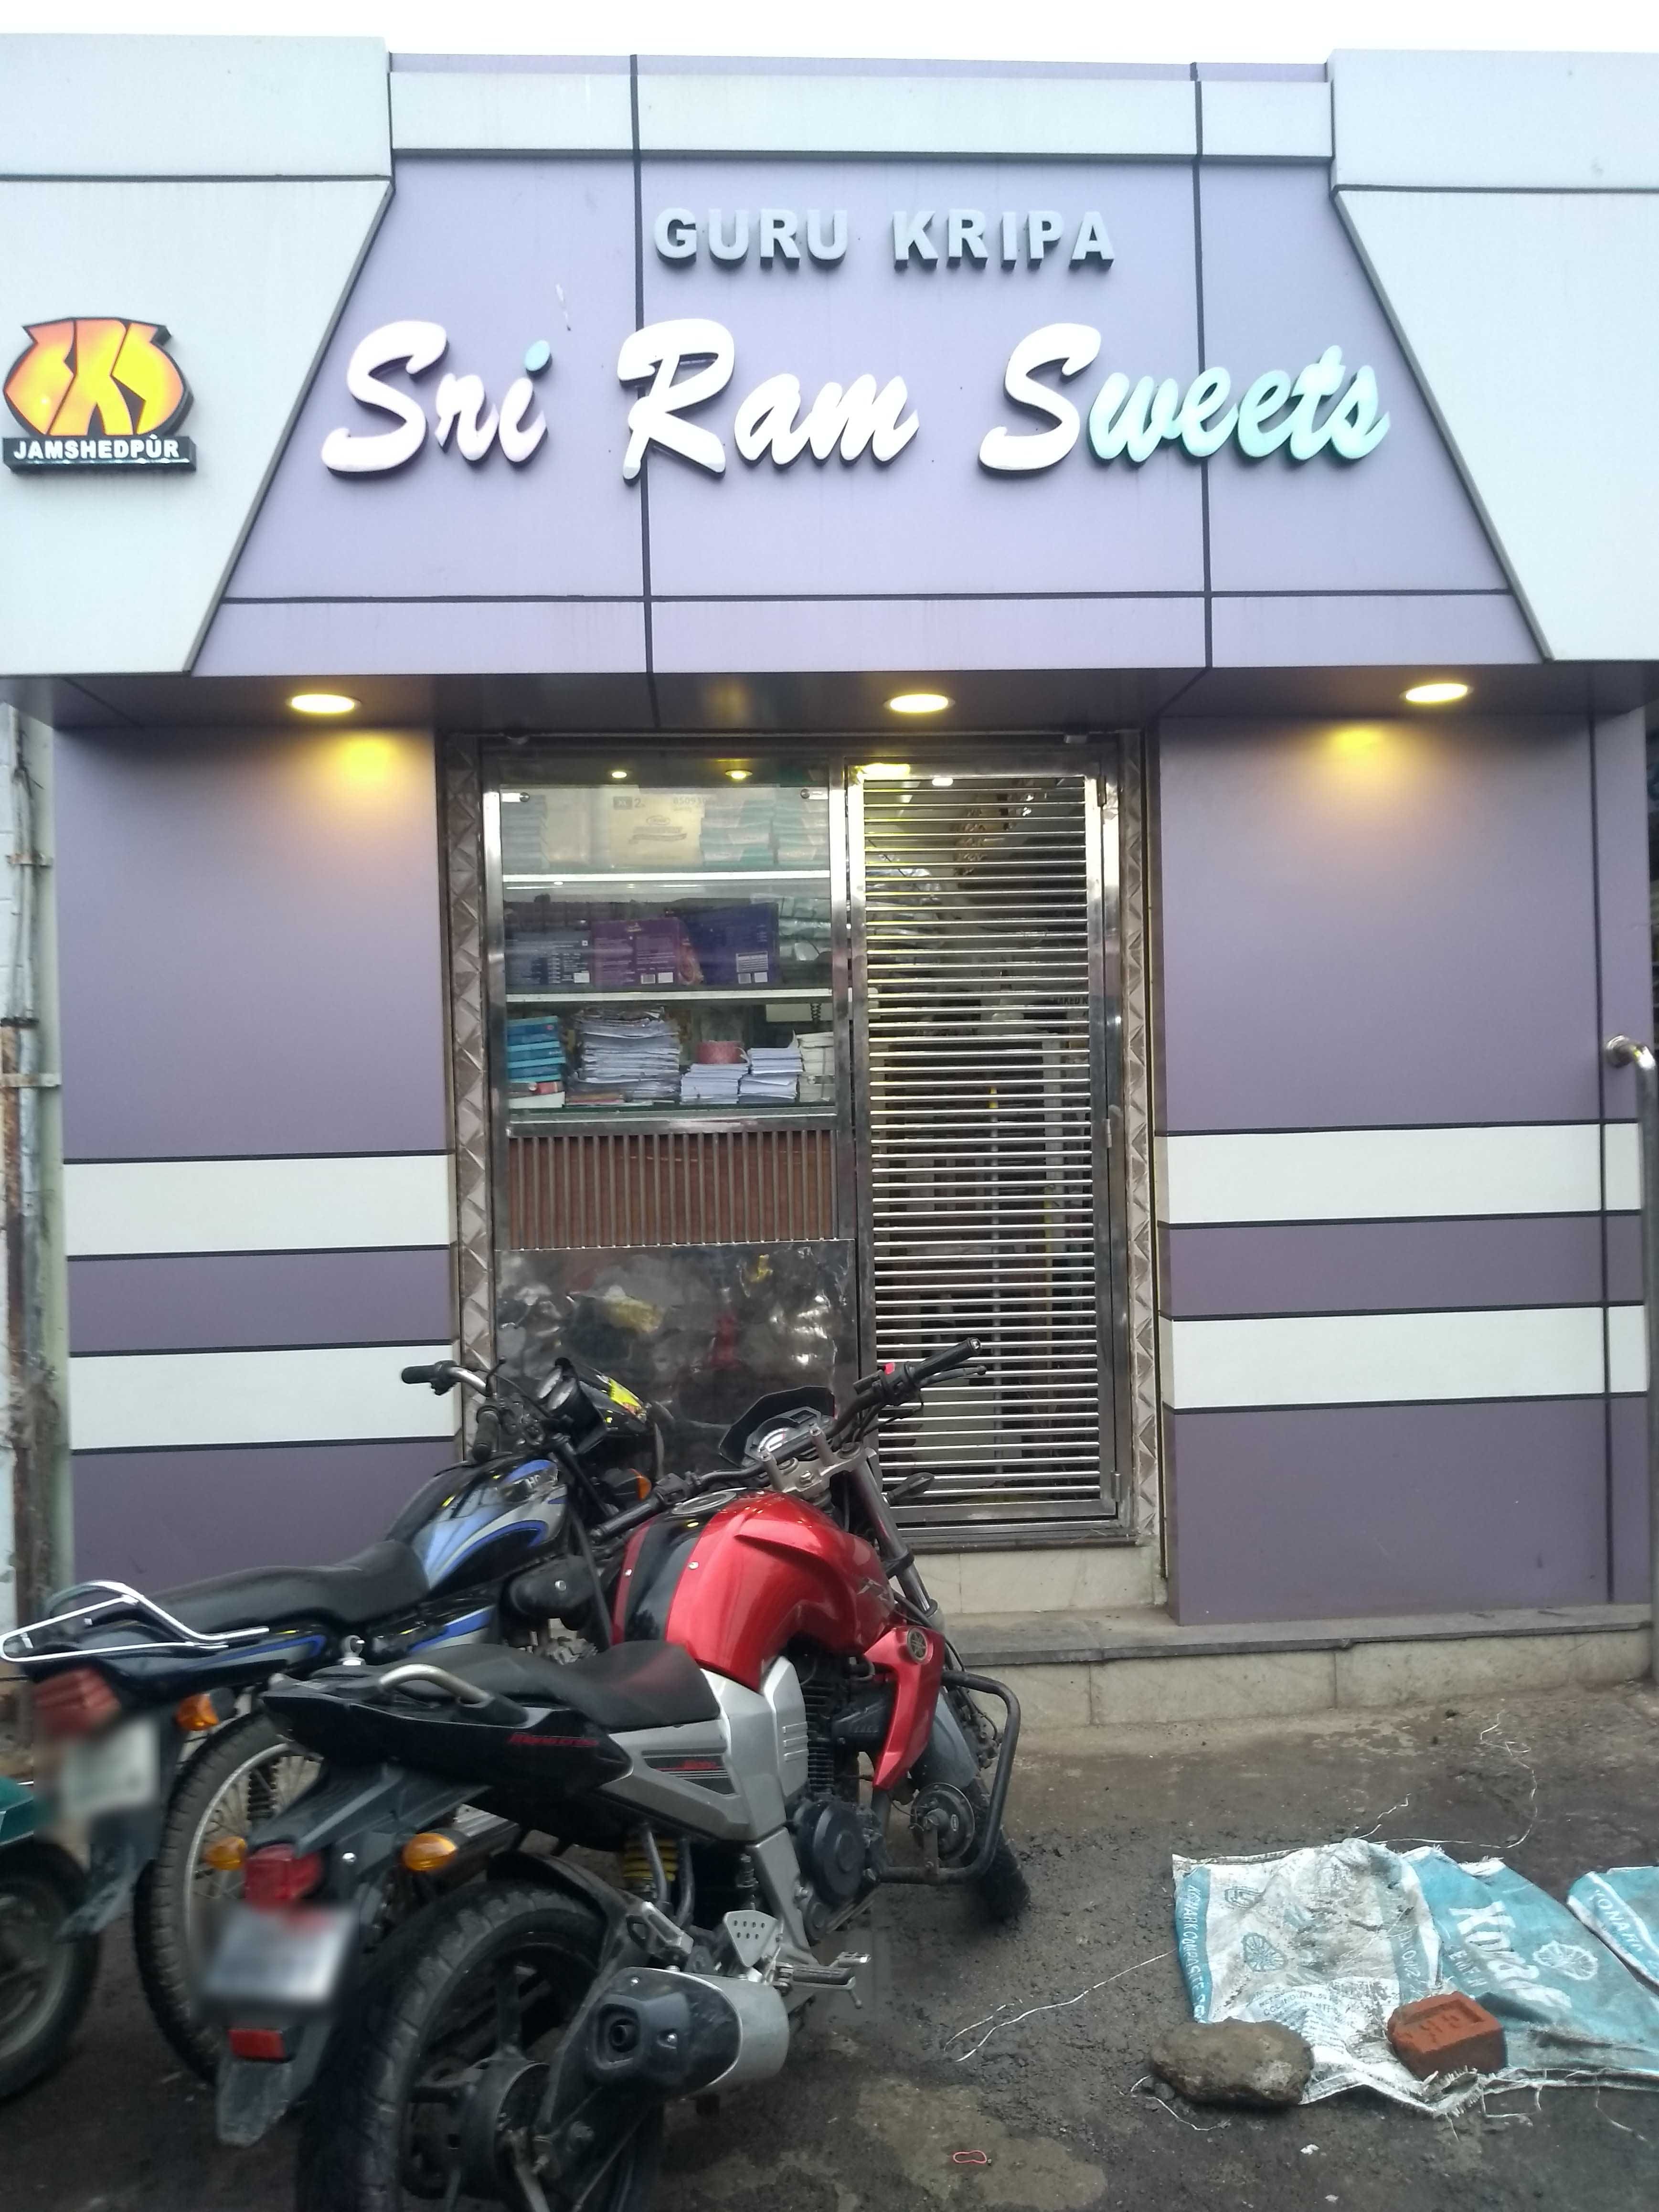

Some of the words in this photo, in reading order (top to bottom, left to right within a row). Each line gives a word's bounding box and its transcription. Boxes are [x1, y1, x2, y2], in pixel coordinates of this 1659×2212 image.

[653, 207, 848, 266] GURU
[891, 209, 1116, 267] KRIPA
[321, 320, 549, 473] Sri
[617, 318, 920, 480] Ram
[978, 322, 1392, 471] Sweets
[13, 436, 180, 460] JAMSHEDPUR
